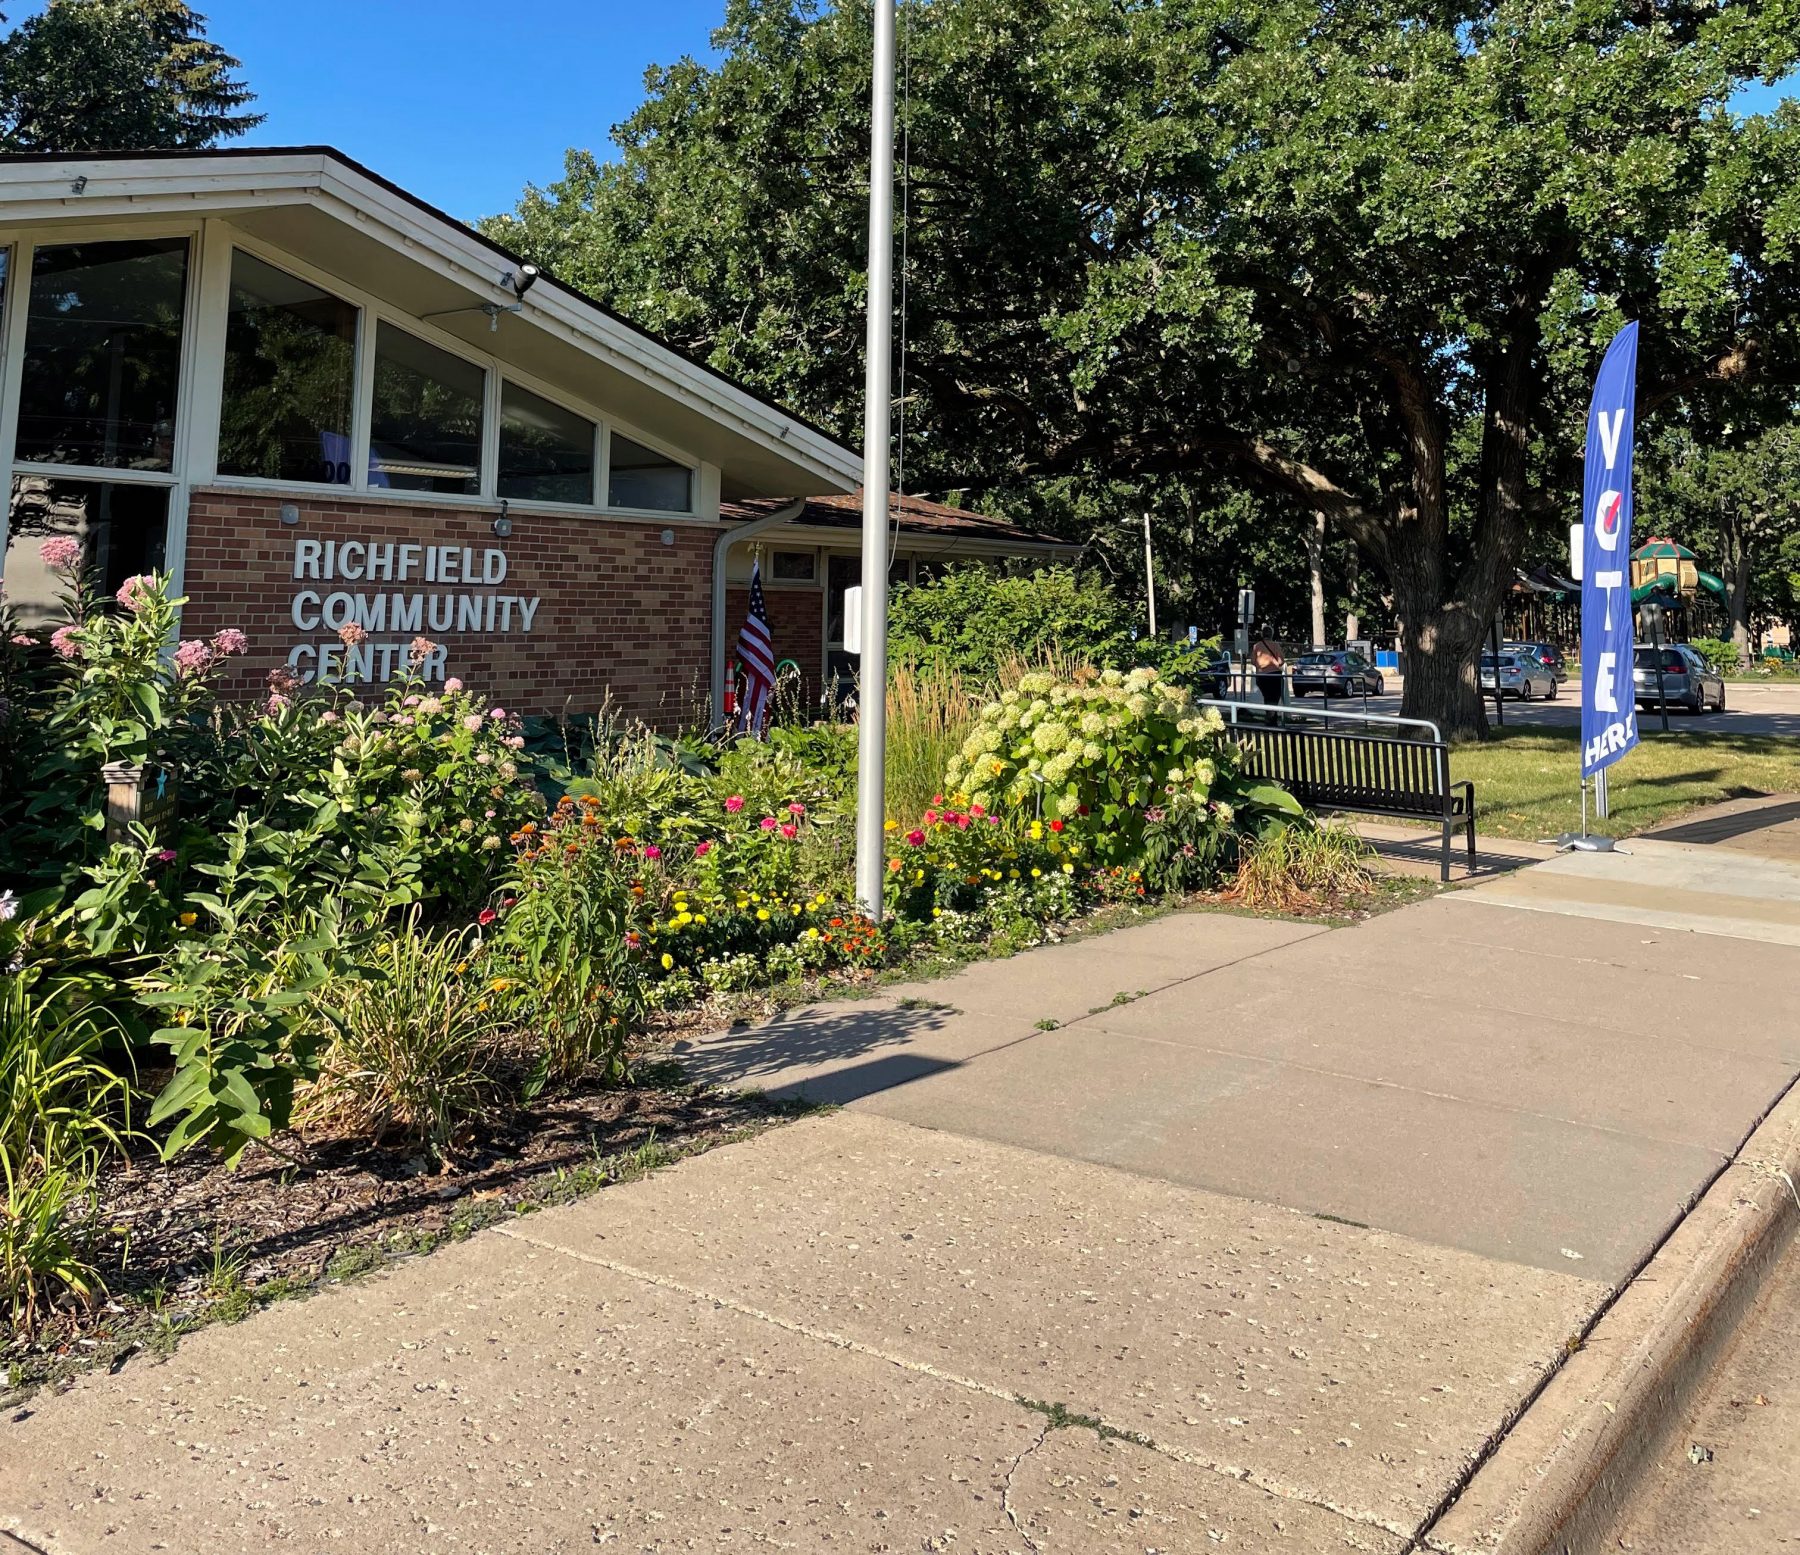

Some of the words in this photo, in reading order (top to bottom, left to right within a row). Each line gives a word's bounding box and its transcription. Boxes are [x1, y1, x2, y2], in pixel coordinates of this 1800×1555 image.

[293, 539, 508, 585] RICHFIELD
[1594, 408, 1625, 713] VOTE
[291, 590, 541, 632] COMMUNITY
